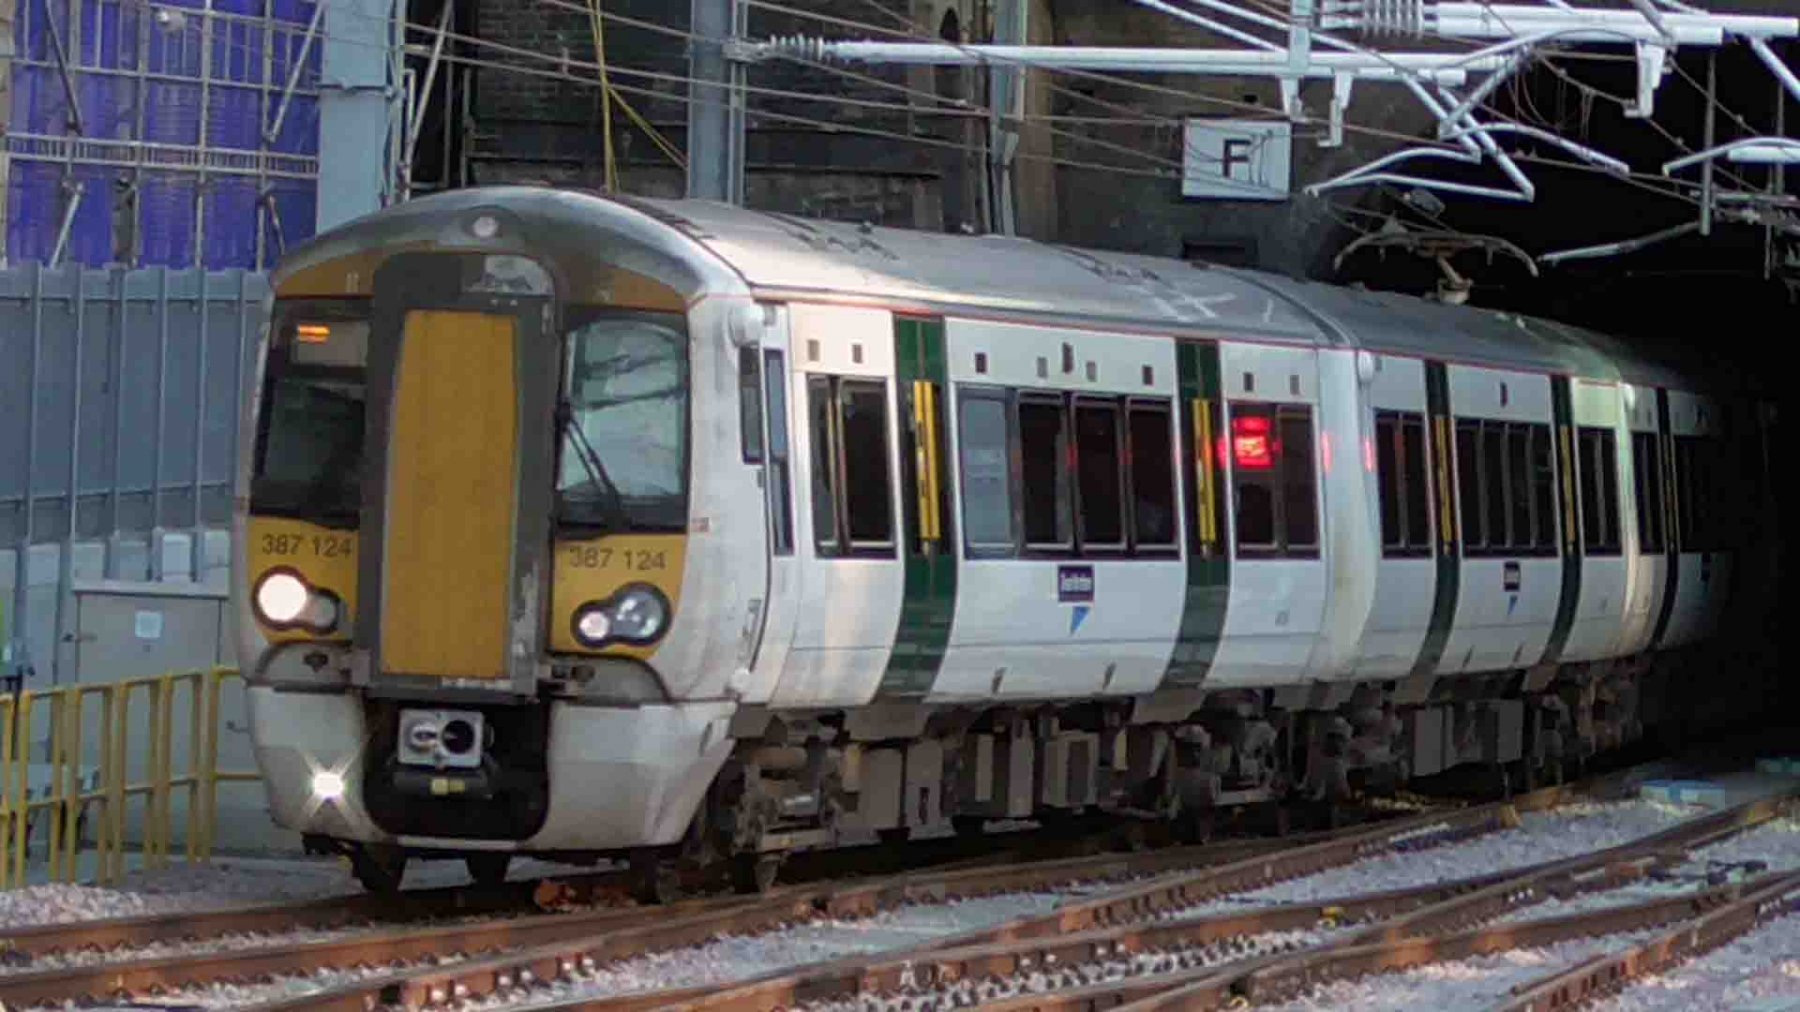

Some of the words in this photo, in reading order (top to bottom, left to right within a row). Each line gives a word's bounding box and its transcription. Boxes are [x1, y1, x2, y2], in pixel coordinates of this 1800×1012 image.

[1223, 138, 1252, 178] F
[262, 533, 303, 555] 387
[312, 535, 352, 560] 124
[570, 546, 613, 569] 387
[624, 549, 666, 571] 124
